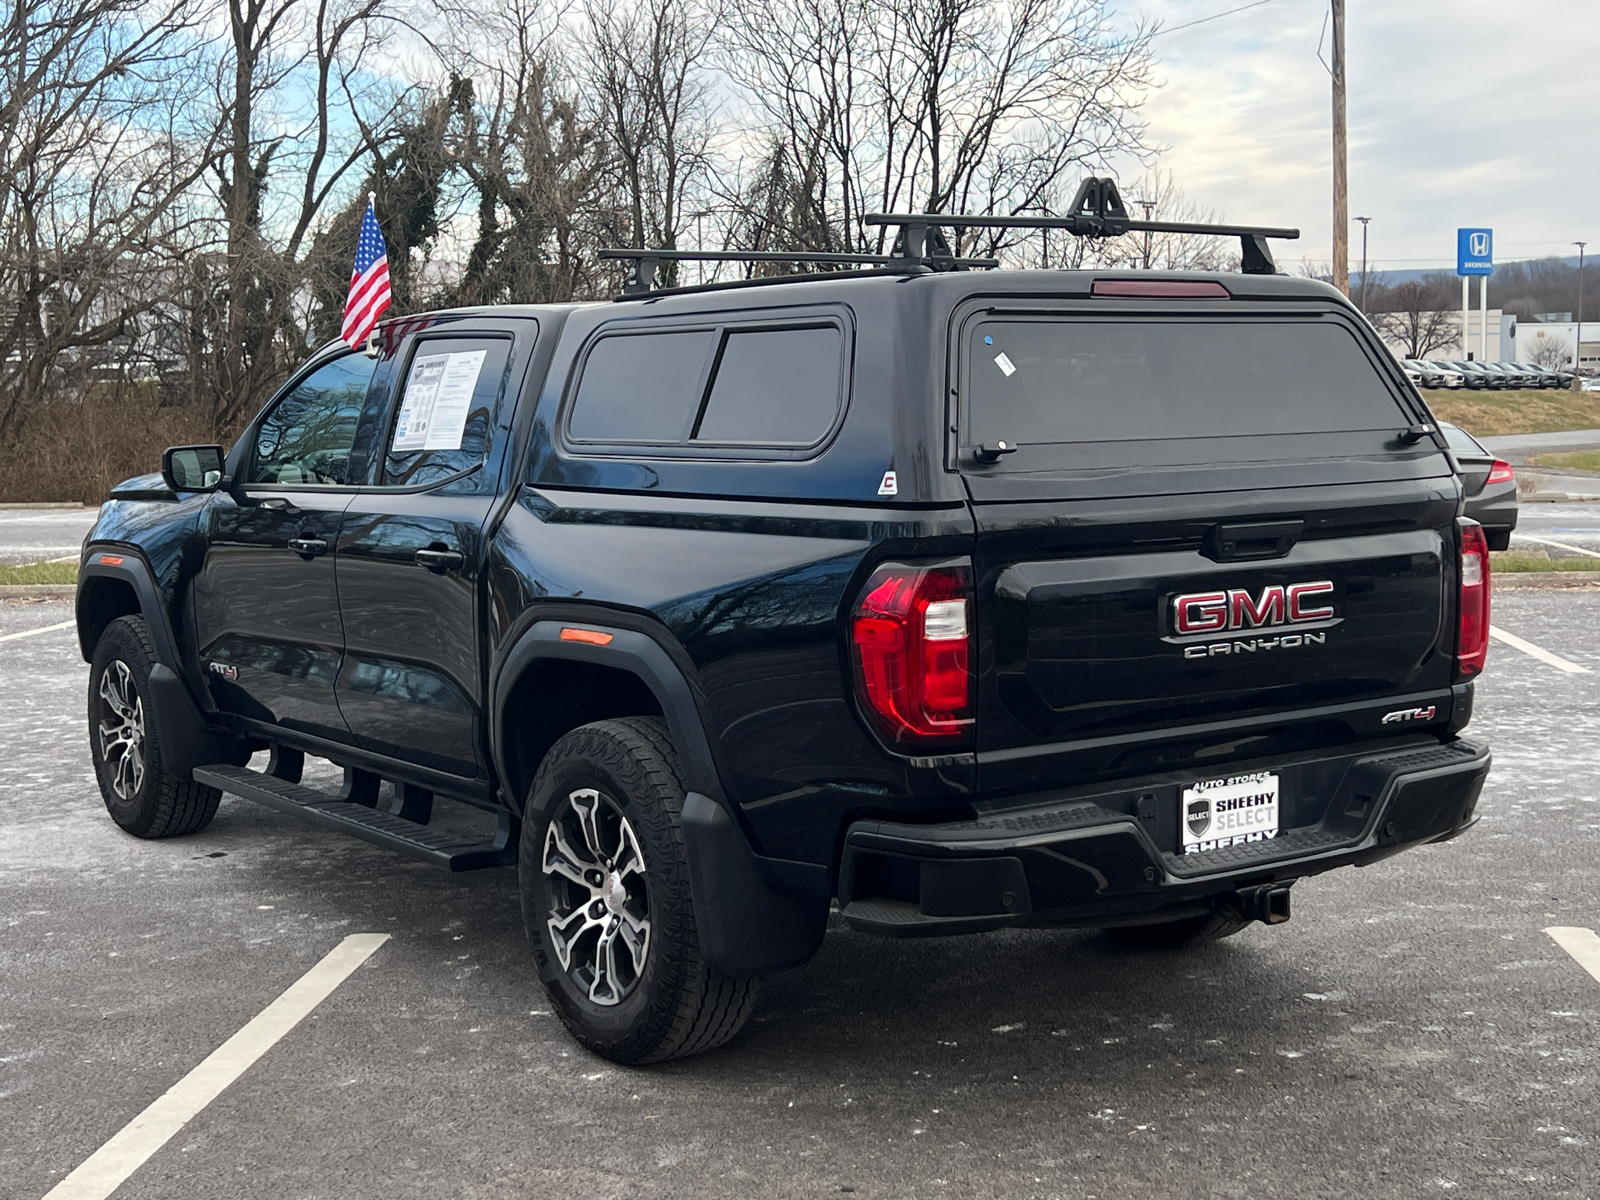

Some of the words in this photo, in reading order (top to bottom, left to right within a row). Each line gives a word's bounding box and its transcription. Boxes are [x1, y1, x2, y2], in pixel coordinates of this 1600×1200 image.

[1463, 261, 1492, 269] HONDA
[1173, 580, 1334, 635] GMC
[1184, 632, 1326, 659] CANYON
[1381, 705, 1436, 725] AT4
[1191, 779, 1225, 792] AUTO
[1226, 771, 1271, 786] STORES
[1216, 791, 1275, 812] SHEEHY
[1187, 811, 1210, 822] SELECT
[1216, 806, 1275, 831] SELECT
